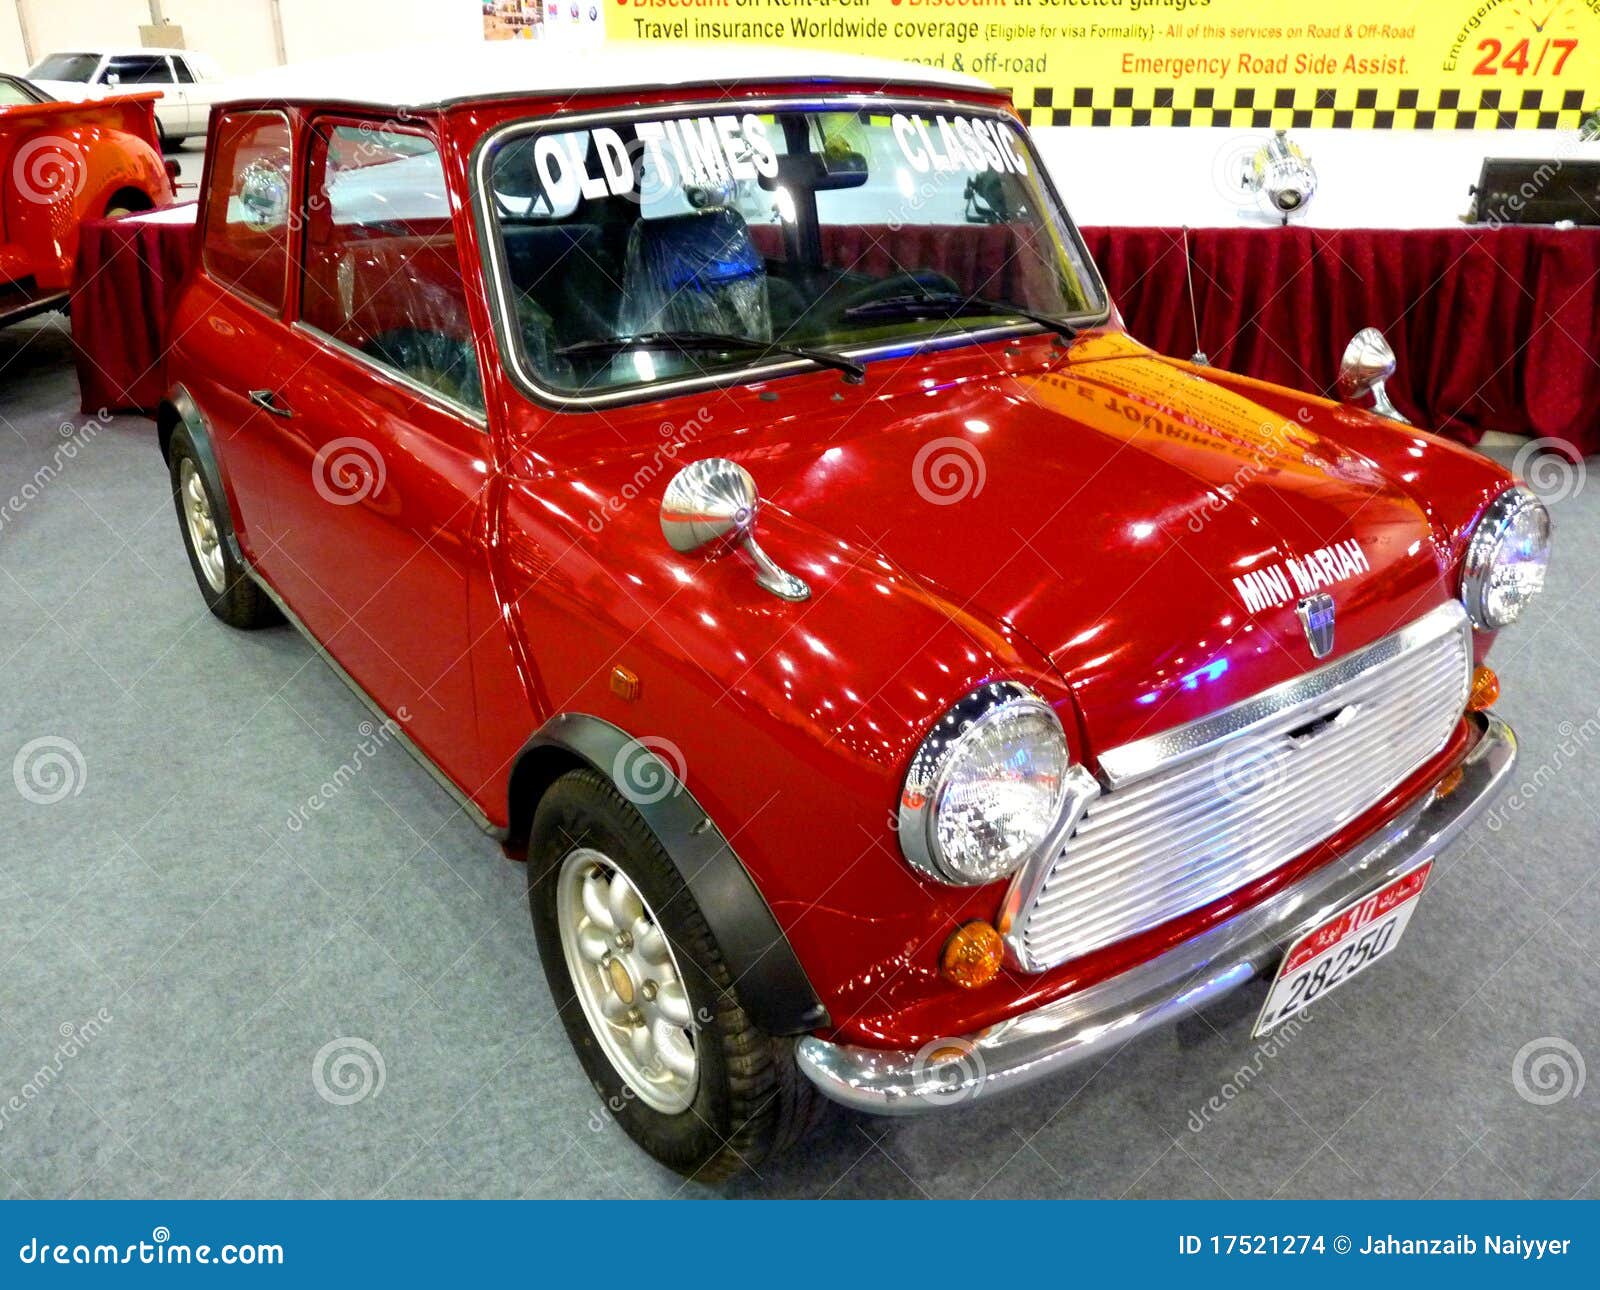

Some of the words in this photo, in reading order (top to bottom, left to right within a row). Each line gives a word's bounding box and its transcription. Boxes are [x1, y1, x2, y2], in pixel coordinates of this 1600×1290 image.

[633, 17, 688, 39] Travel
[695, 17, 785, 39] insurance
[791, 16, 888, 38] Worldwide
[894, 22, 979, 44] coverage
[1040, 23, 1057, 39] for
[1061, 23, 1086, 39] visa
[1166, 23, 1183, 38] All
[1186, 23, 1200, 39] of
[1202, 23, 1226, 39] this
[1229, 23, 1283, 39] services
[1286, 27, 1303, 39] on
[1307, 23, 1341, 39] Road
[1343, 23, 1354, 39] &
[1357, 23, 1416, 40] Off-Road
[1442, 0, 1503, 71] Emergen
[904, 53, 945, 68] ad
[952, 52, 965, 73] &
[972, 52, 1047, 73] off-road
[1121, 52, 1231, 79] Emergency
[1237, 53, 1289, 75] Road
[1294, 53, 1338, 75] Side
[1343, 53, 1409, 75] Assist.
[1472, 37, 1579, 76] 24/7
[534, 127, 635, 203] OLD
[634, 113, 779, 187] TIMES
[891, 113, 1028, 177] CLASSIC
[1231, 563, 1294, 614] MINI
[1284, 537, 1371, 596] MARIAH
[1341, 894, 1379, 941] 10
[1277, 915, 1398, 1019] 28250
